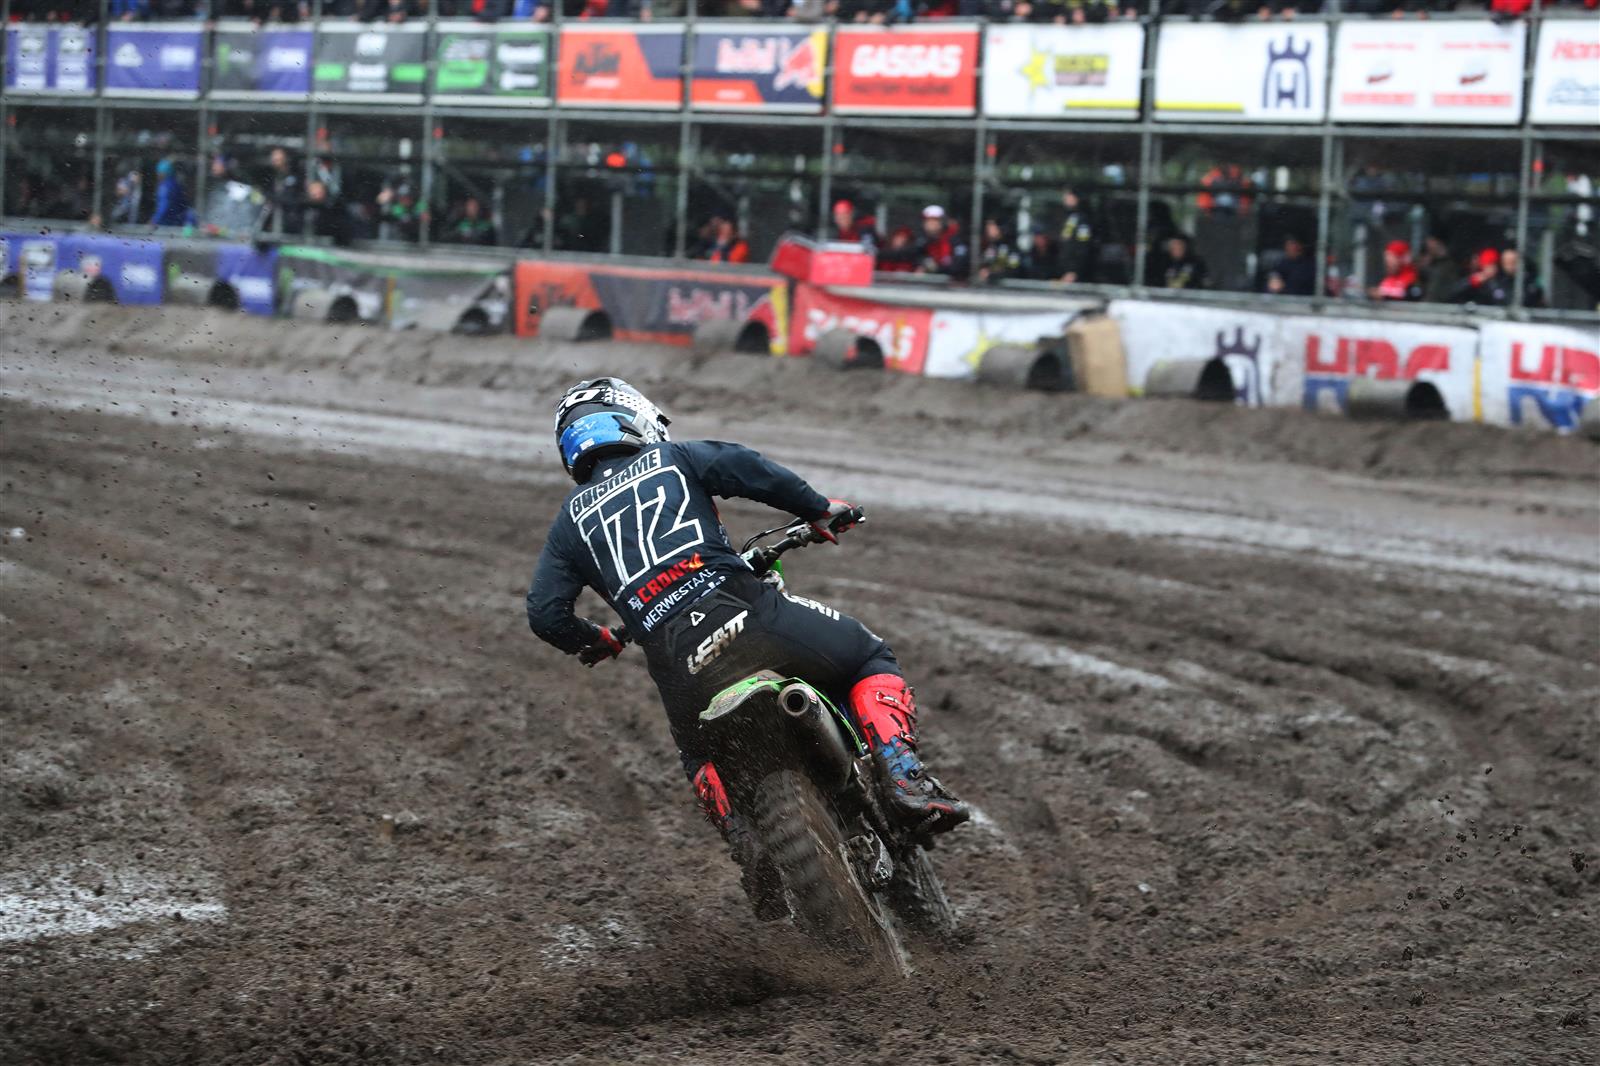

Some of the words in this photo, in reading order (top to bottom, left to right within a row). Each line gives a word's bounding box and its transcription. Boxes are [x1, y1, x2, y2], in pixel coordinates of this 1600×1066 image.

[851, 44, 963, 78] GASGAS
[577, 464, 705, 601] 172
[642, 568, 717, 632] MERWESTAAL
